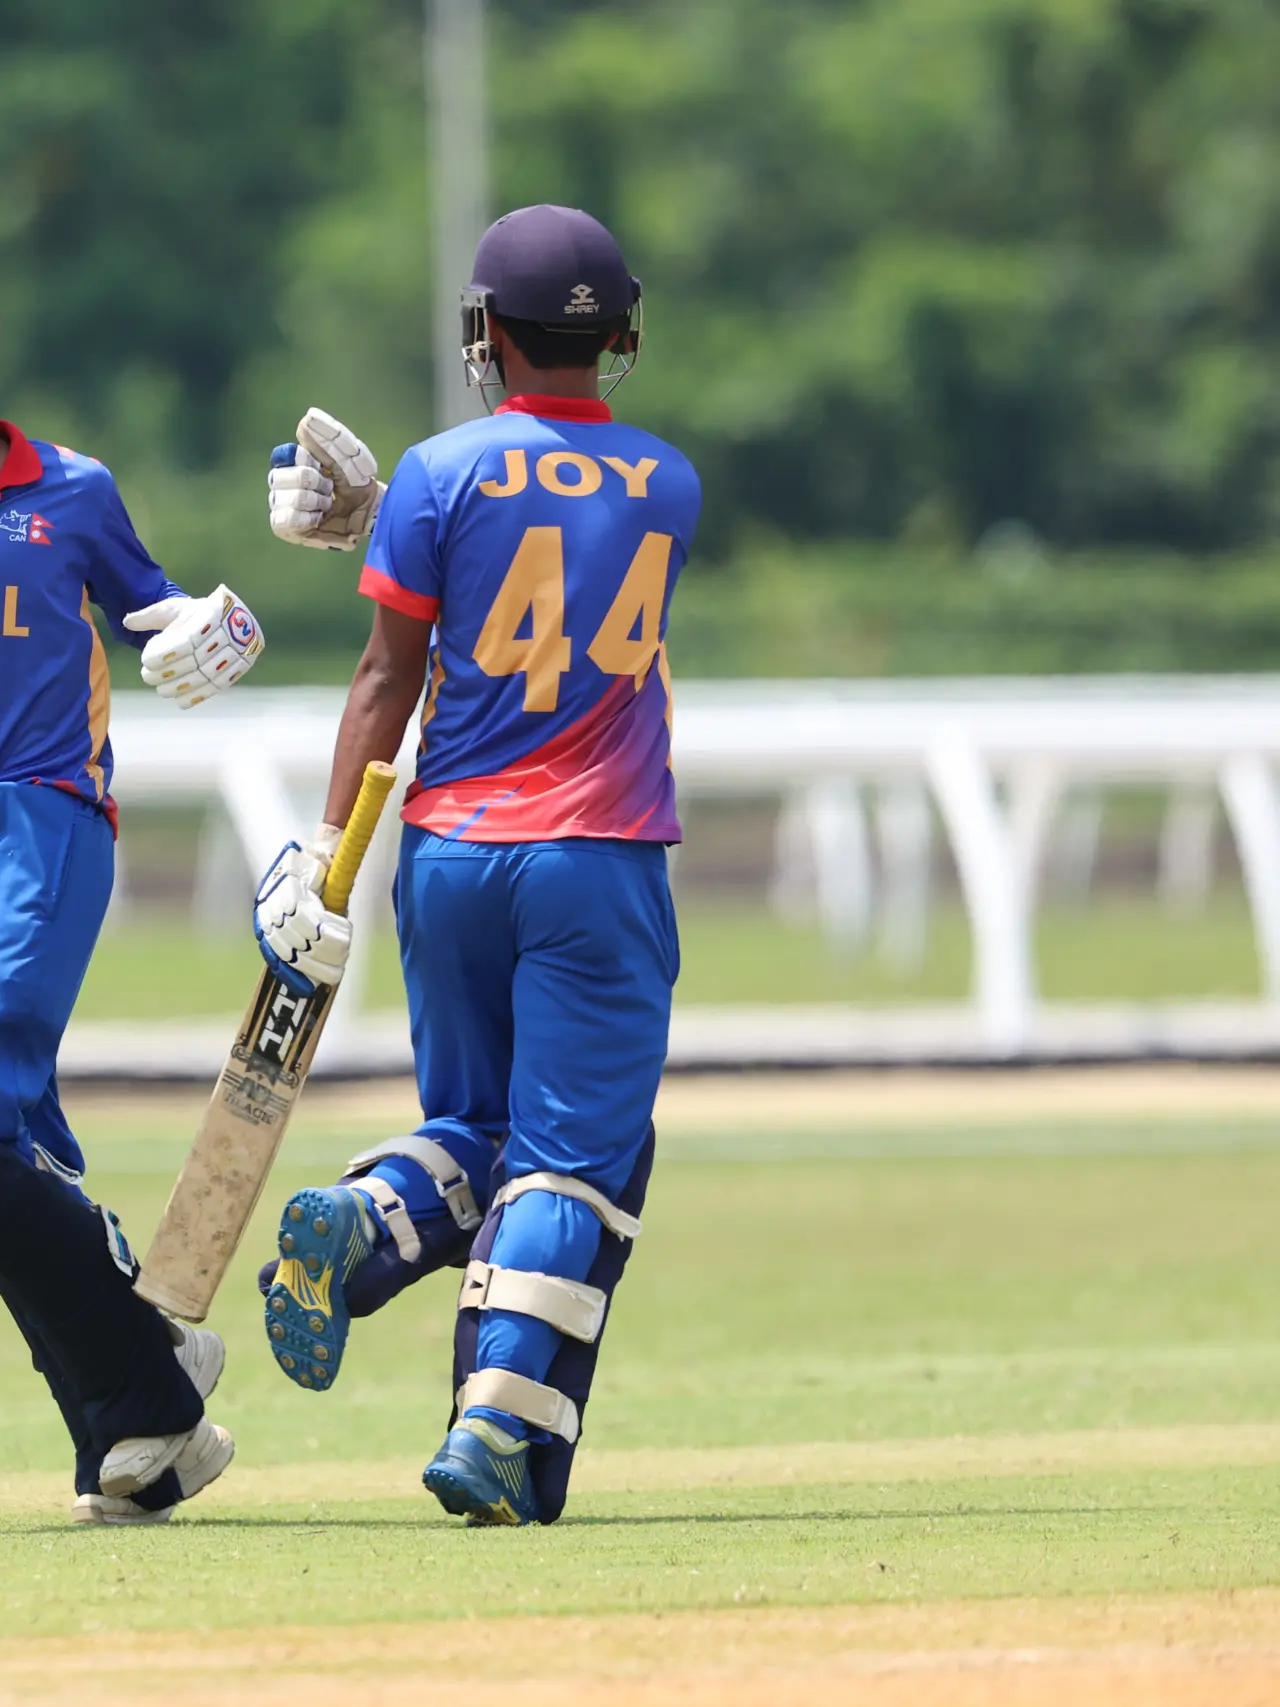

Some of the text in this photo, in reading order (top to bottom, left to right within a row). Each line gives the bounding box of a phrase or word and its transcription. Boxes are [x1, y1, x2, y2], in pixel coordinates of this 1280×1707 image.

[563, 303, 600, 315] SHREY
[479, 449, 658, 498] JOY
[9, 534, 26, 542] CAN
[472, 526, 673, 712] 44
